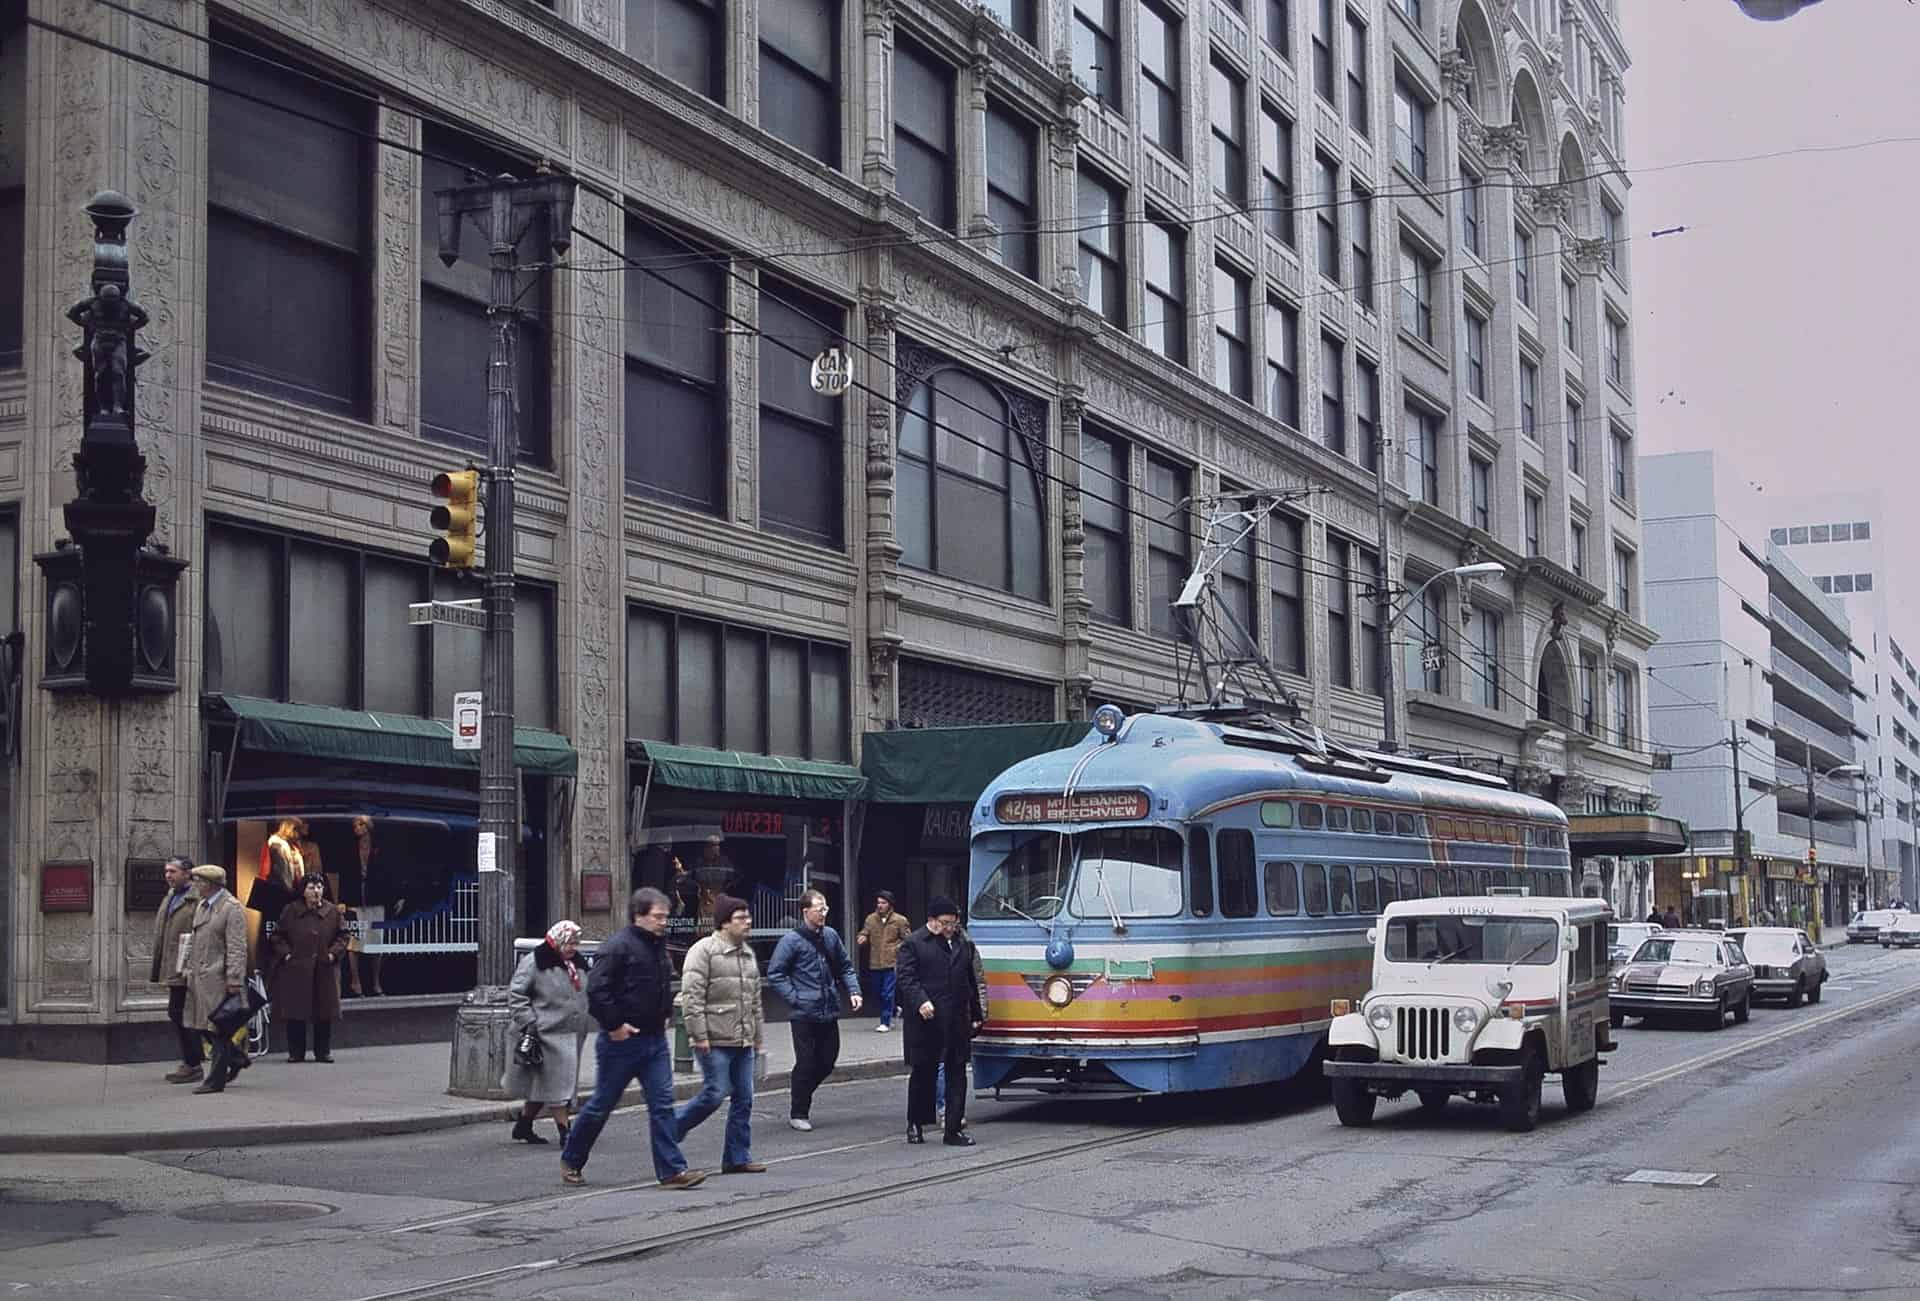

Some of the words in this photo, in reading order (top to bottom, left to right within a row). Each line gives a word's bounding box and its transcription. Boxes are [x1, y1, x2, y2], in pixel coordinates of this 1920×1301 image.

[818, 354, 848, 371] CAR
[815, 374, 848, 390] STOP
[1071, 794, 1137, 808] LEBANON
[1047, 807, 1137, 819] BEECHVIEW
